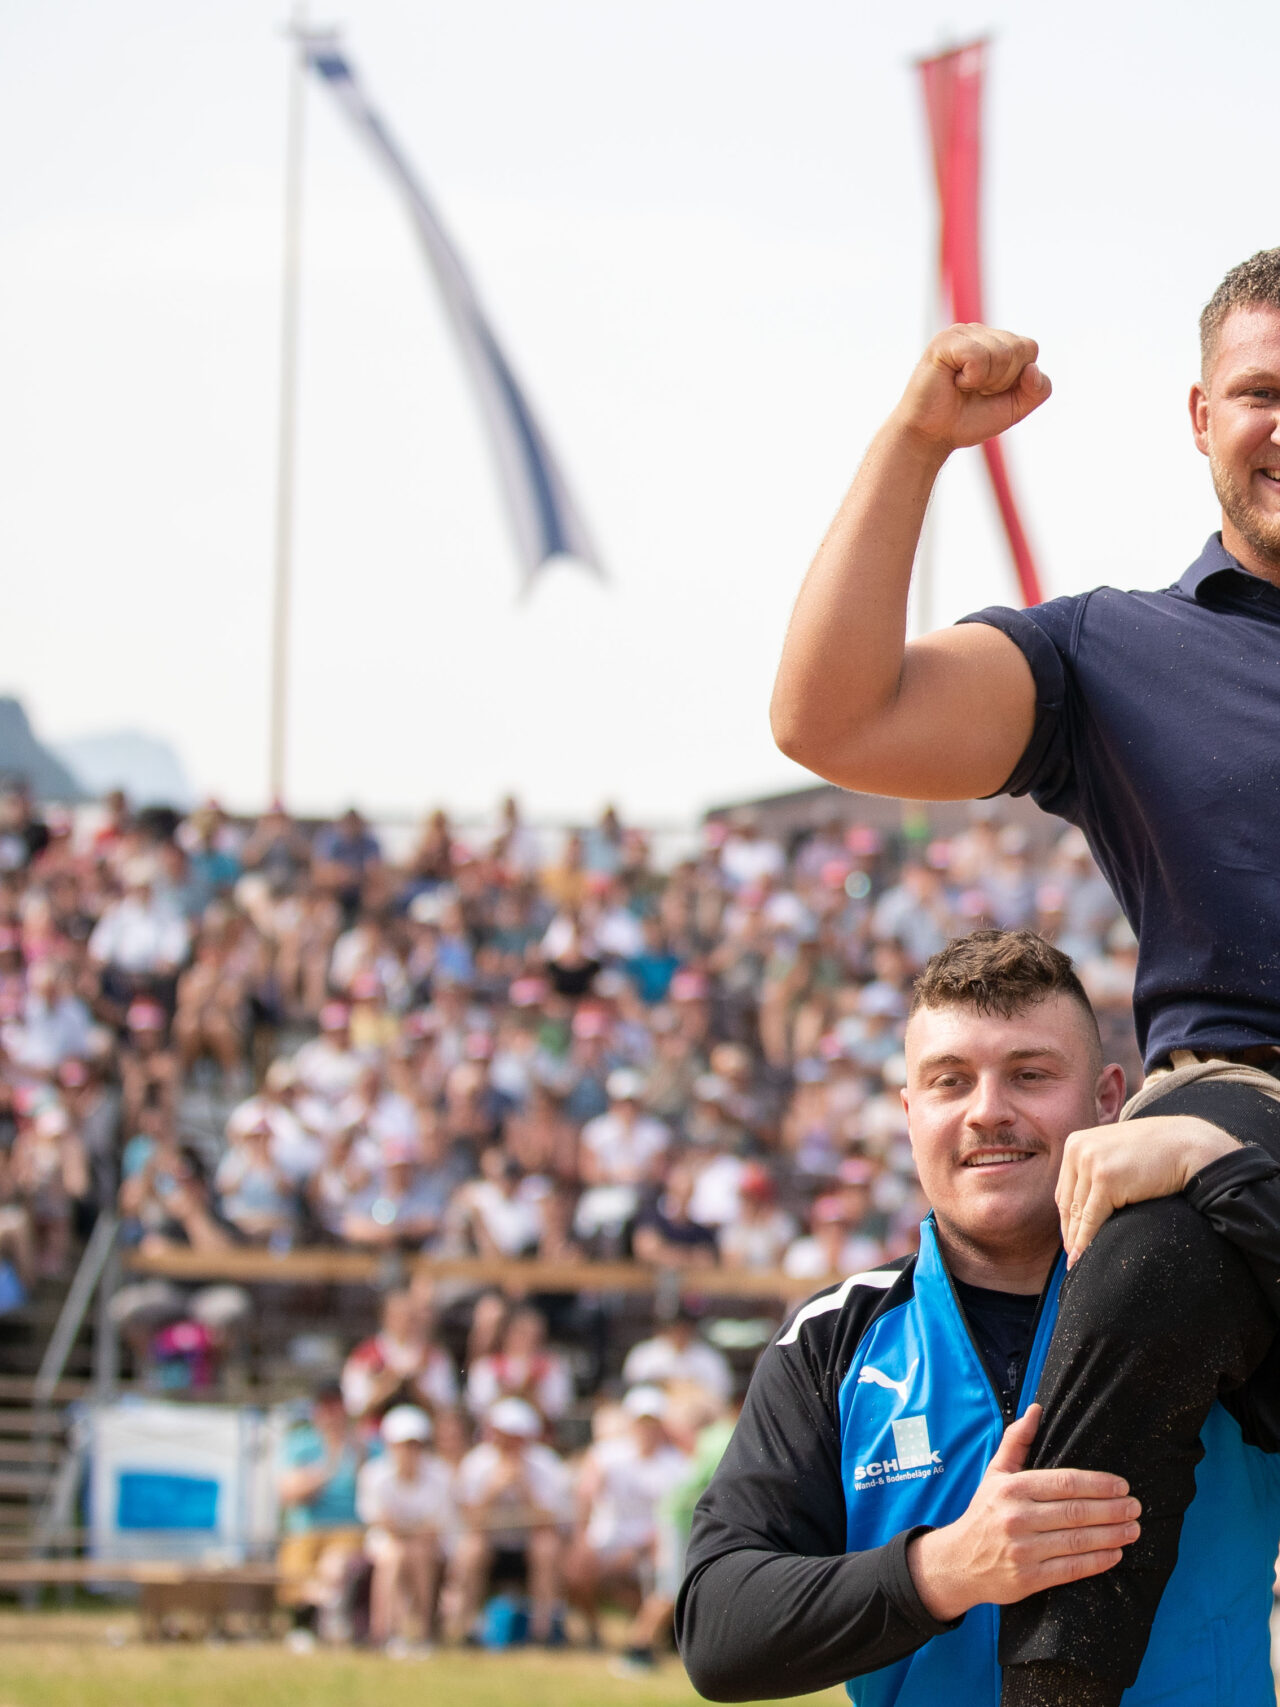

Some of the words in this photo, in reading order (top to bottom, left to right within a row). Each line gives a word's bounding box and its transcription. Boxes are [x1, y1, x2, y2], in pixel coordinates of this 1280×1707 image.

[854, 1450, 943, 1481] SCHENK
[886, 1469, 932, 1483] Bodenbeläge
[933, 1465, 944, 1475] AG
